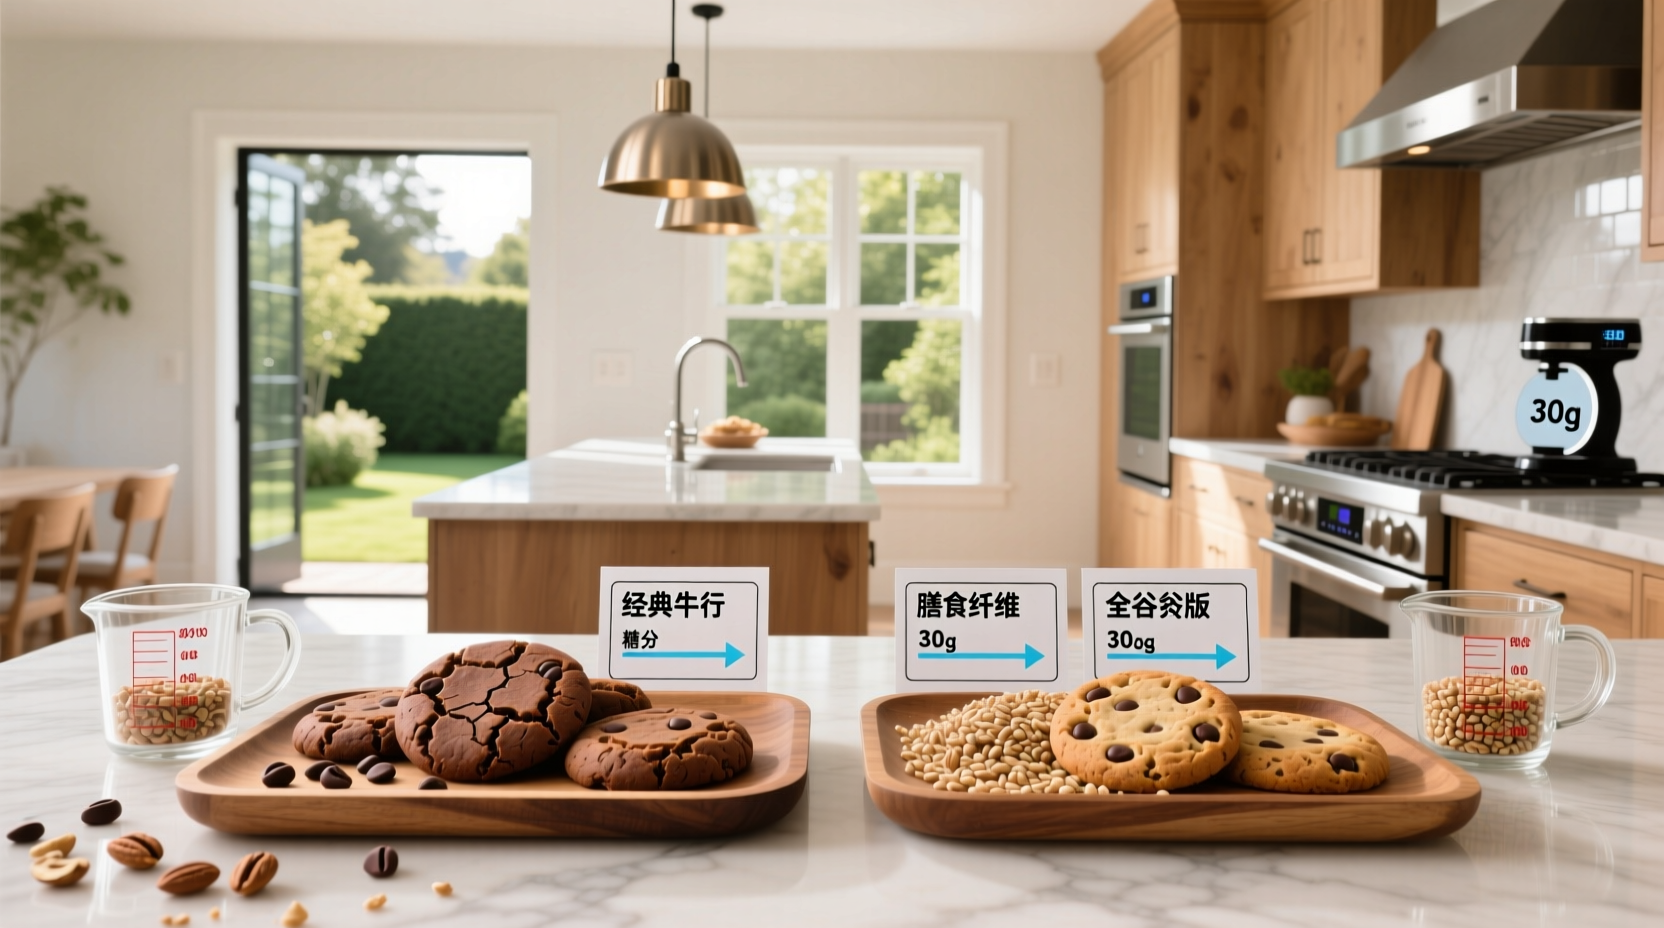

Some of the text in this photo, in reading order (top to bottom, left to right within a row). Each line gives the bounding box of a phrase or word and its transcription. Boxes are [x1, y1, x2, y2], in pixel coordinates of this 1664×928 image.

[1530, 398, 1581, 432] 30g
[621, 590, 726, 619] 经典牛行
[916, 590, 1020, 619] 膳食纤维
[918, 629, 957, 654] 30g
